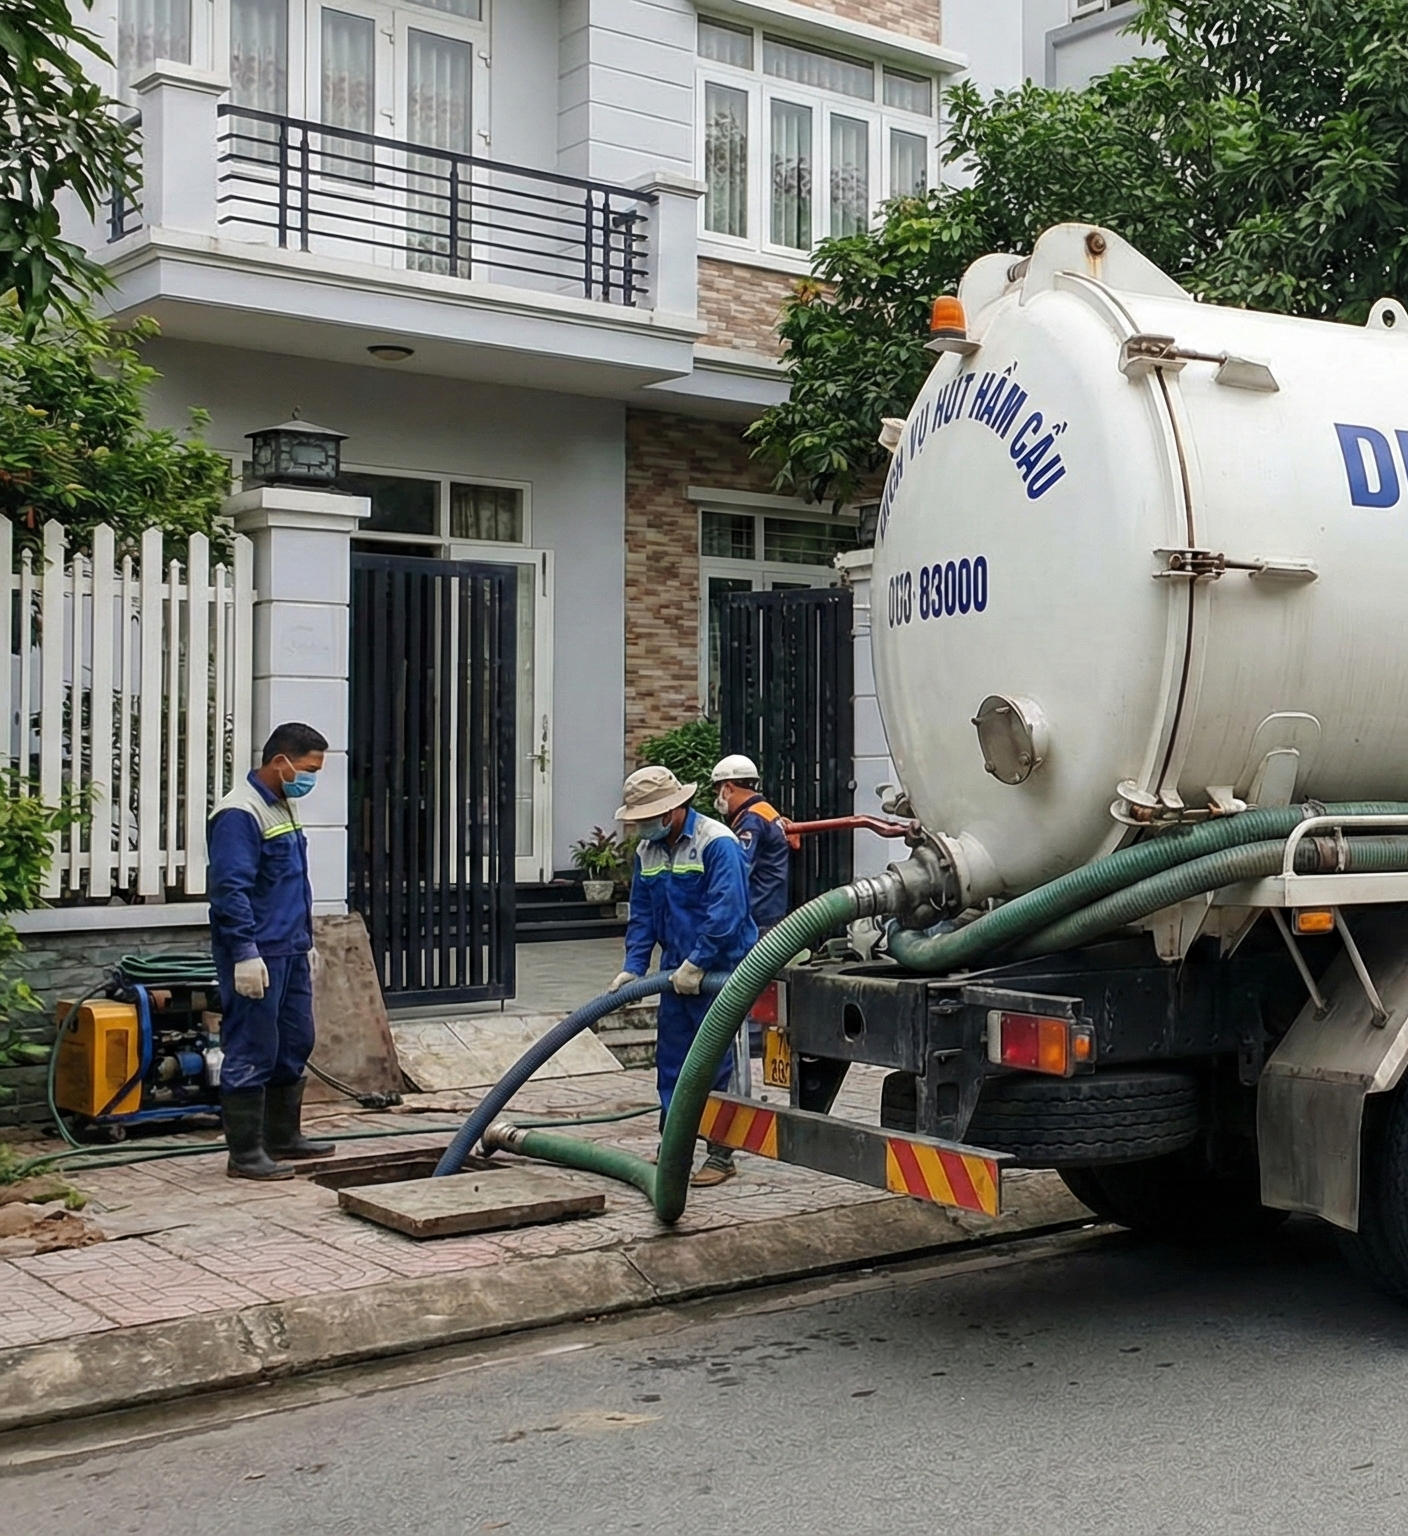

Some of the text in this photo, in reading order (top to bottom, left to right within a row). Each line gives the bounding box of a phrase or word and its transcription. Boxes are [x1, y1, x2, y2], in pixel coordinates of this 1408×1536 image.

[909, 401, 931, 461] VỤ
[931, 367, 976, 434] HÚT
[919, 555, 988, 621] 83000
